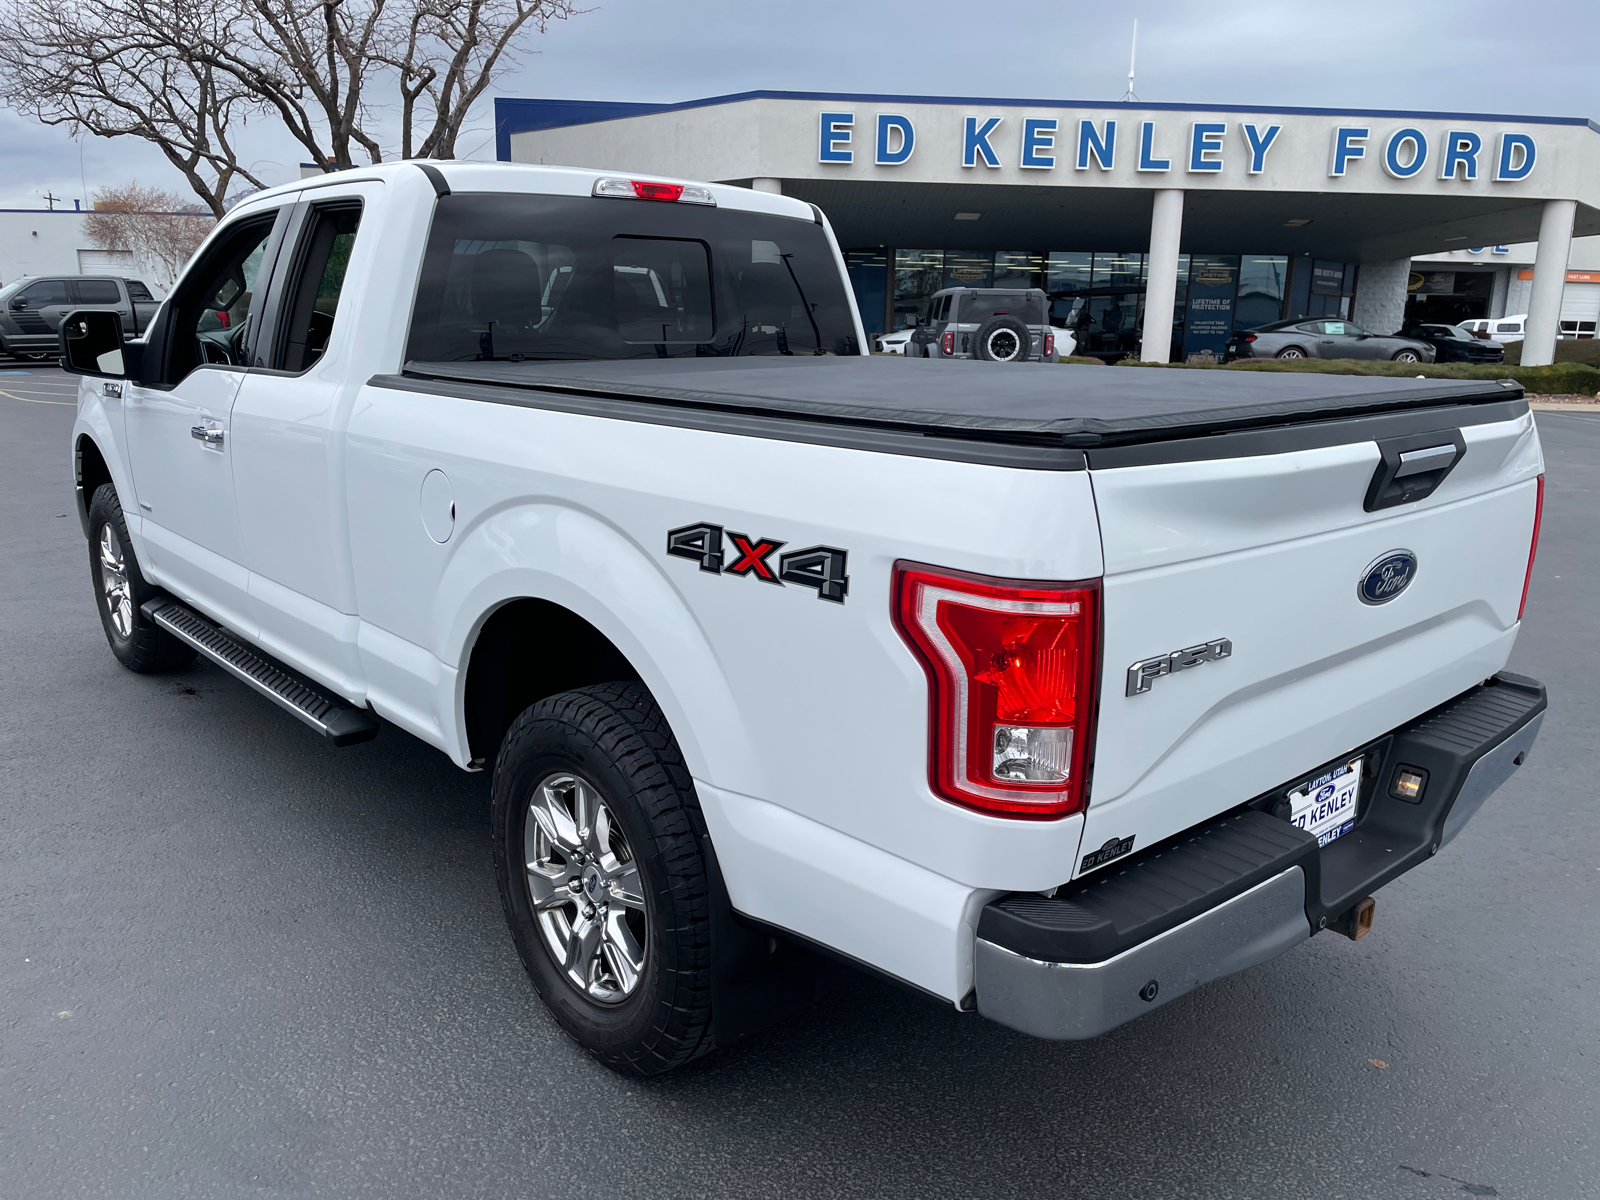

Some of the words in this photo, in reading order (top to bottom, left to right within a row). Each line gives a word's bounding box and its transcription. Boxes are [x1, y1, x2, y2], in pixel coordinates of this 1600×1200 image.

[819, 112, 917, 166] ED
[961, 115, 1282, 176] KENLEY
[1329, 126, 1538, 184] FORD
[1375, 561, 1410, 596] Ford
[1333, 763, 1348, 778] UTAH
[1310, 787, 1355, 826] KENLEY
[1082, 857, 1095, 869] ED
[1097, 840, 1134, 863] KENLEY
